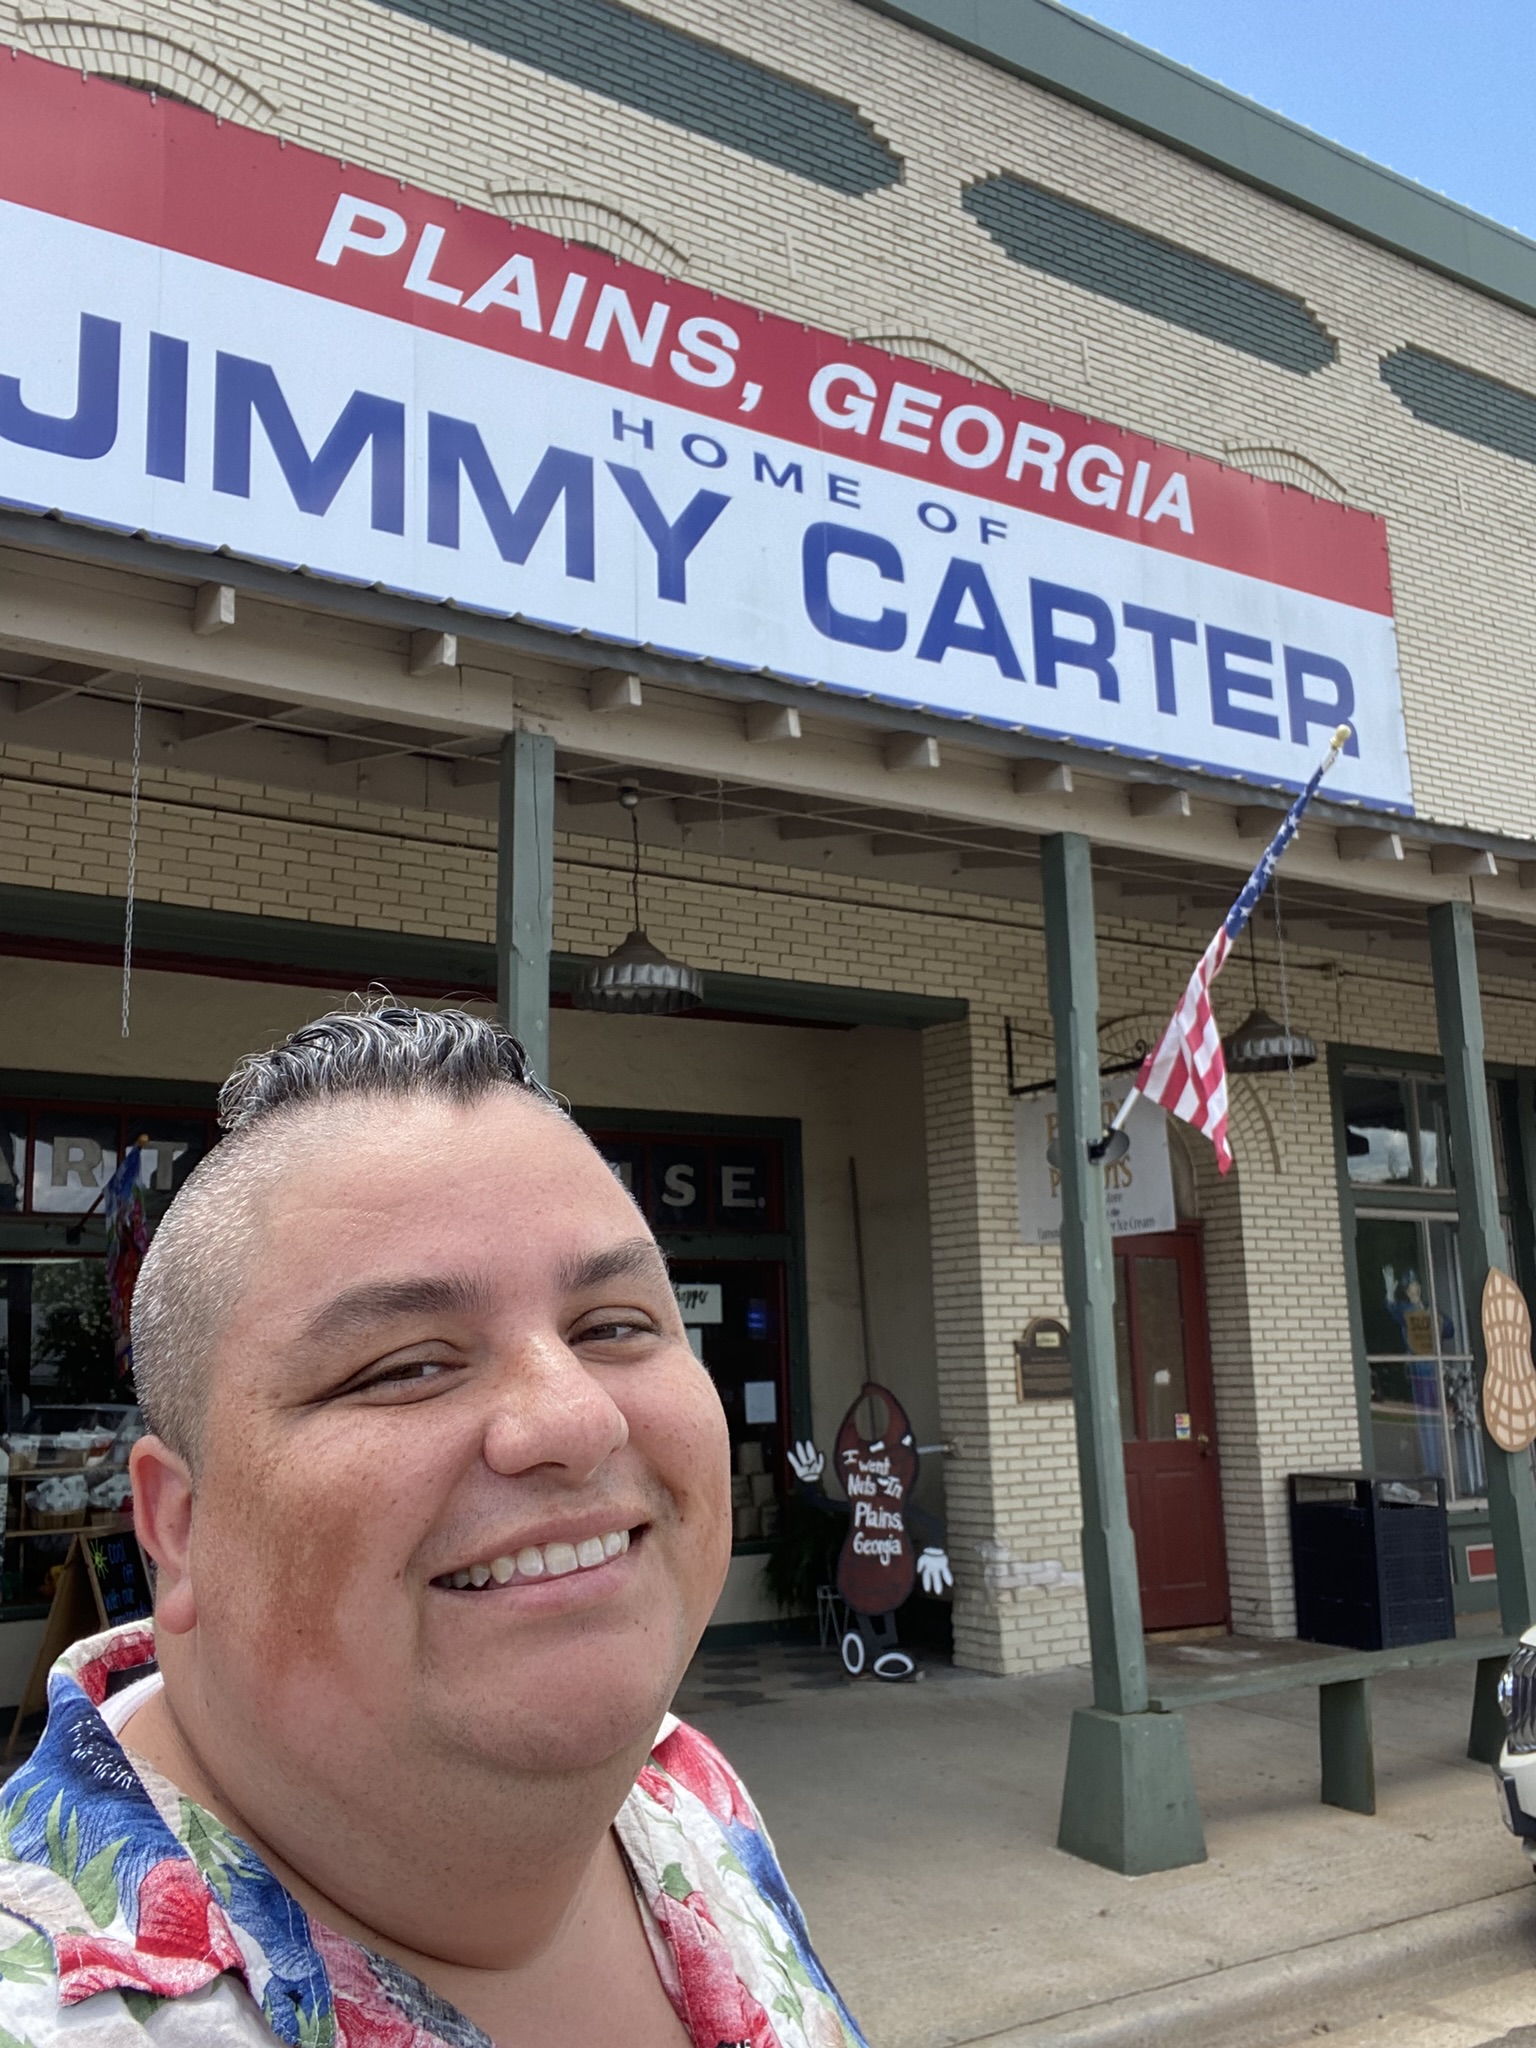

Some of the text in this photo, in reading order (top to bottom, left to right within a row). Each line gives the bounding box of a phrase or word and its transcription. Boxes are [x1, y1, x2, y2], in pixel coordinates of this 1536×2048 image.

[316, 193, 1195, 535] PLAINS, GEORGIA
[612, 408, 1008, 545] HOME OF
[0, 311, 1360, 758] JIMMY CARTER
[842, 1449, 859, 1465] I
[858, 1456, 891, 1476] went
[848, 1473, 903, 1499] Nuts In
[854, 1532, 902, 1566] Georgia
